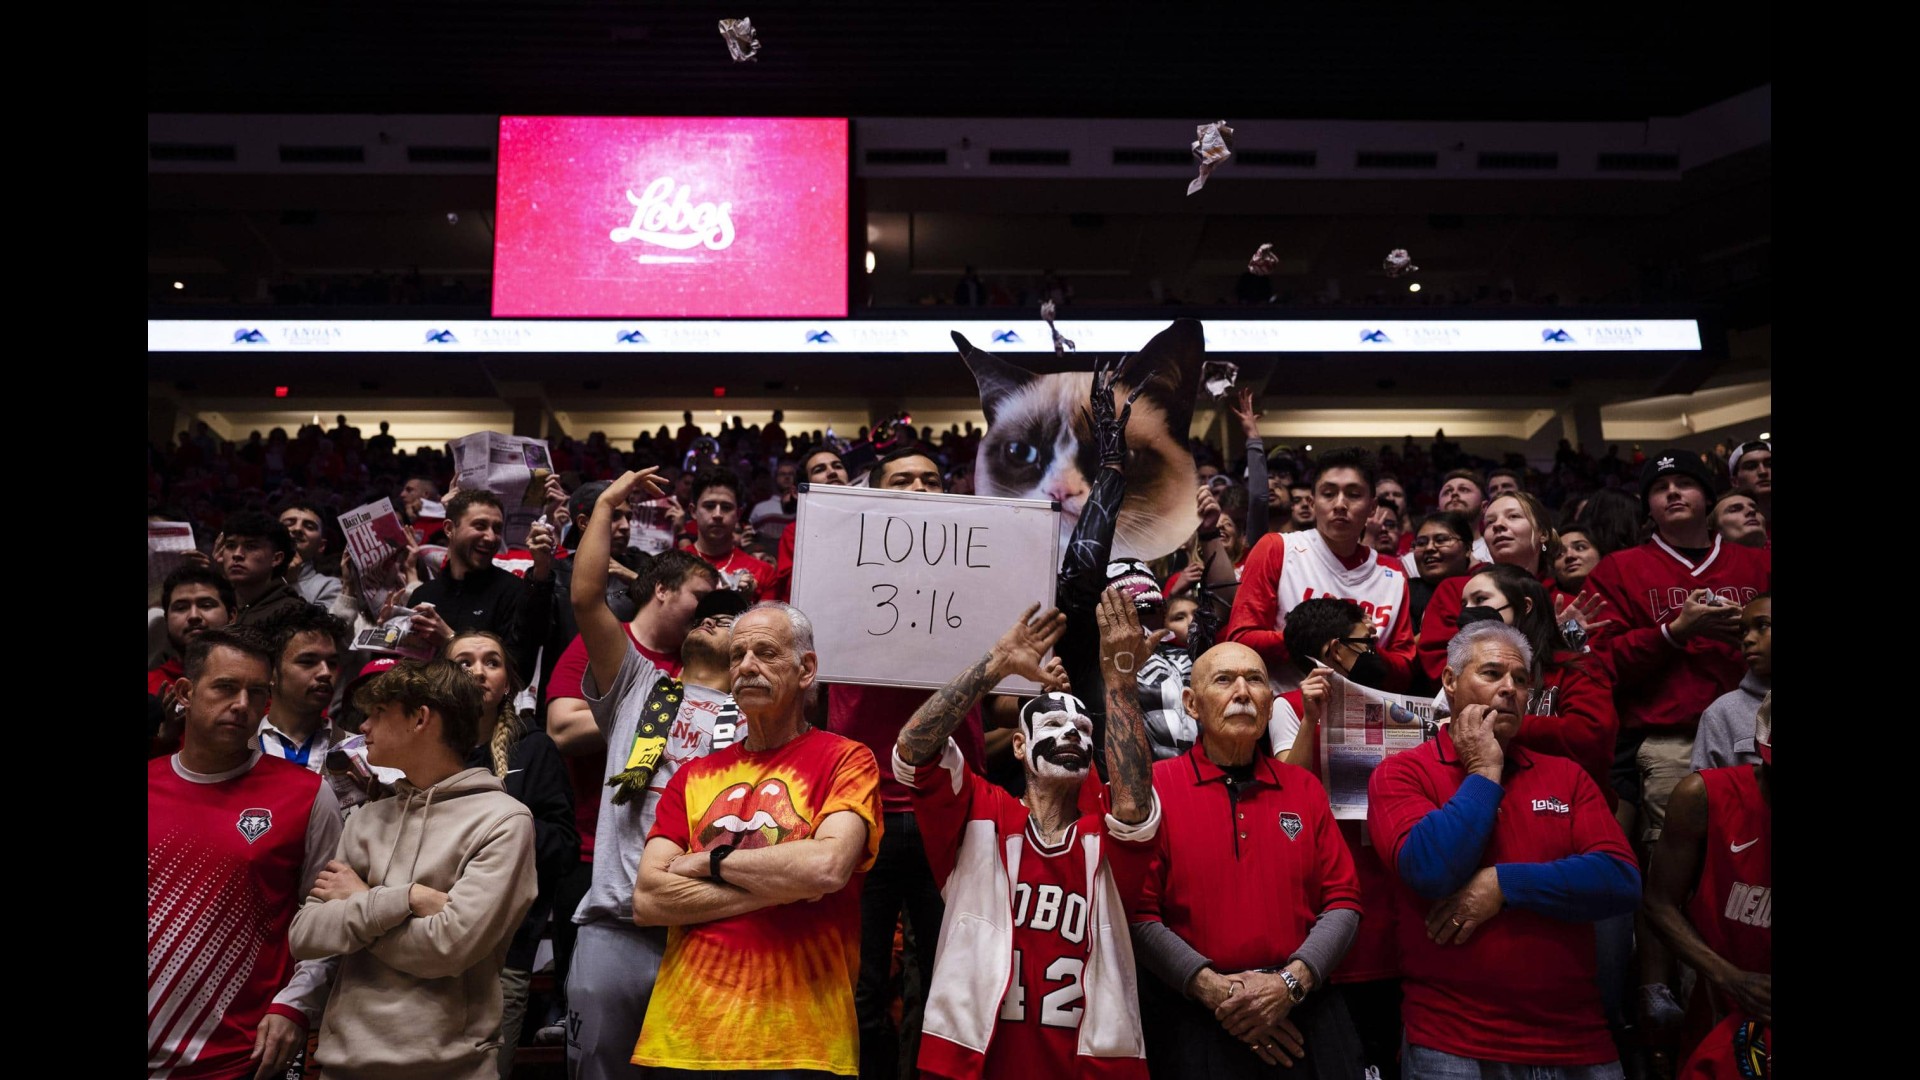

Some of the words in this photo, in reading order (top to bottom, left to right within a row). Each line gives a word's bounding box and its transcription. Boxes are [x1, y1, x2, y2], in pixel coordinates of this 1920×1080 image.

[609, 176, 735, 250] Lobos
[281, 327, 342, 338] TANOAN
[1586, 327, 1643, 337] TANOAN
[347, 521, 383, 555] THE
[856, 512, 990, 568] LOUIE
[867, 584, 962, 636] 3:16
